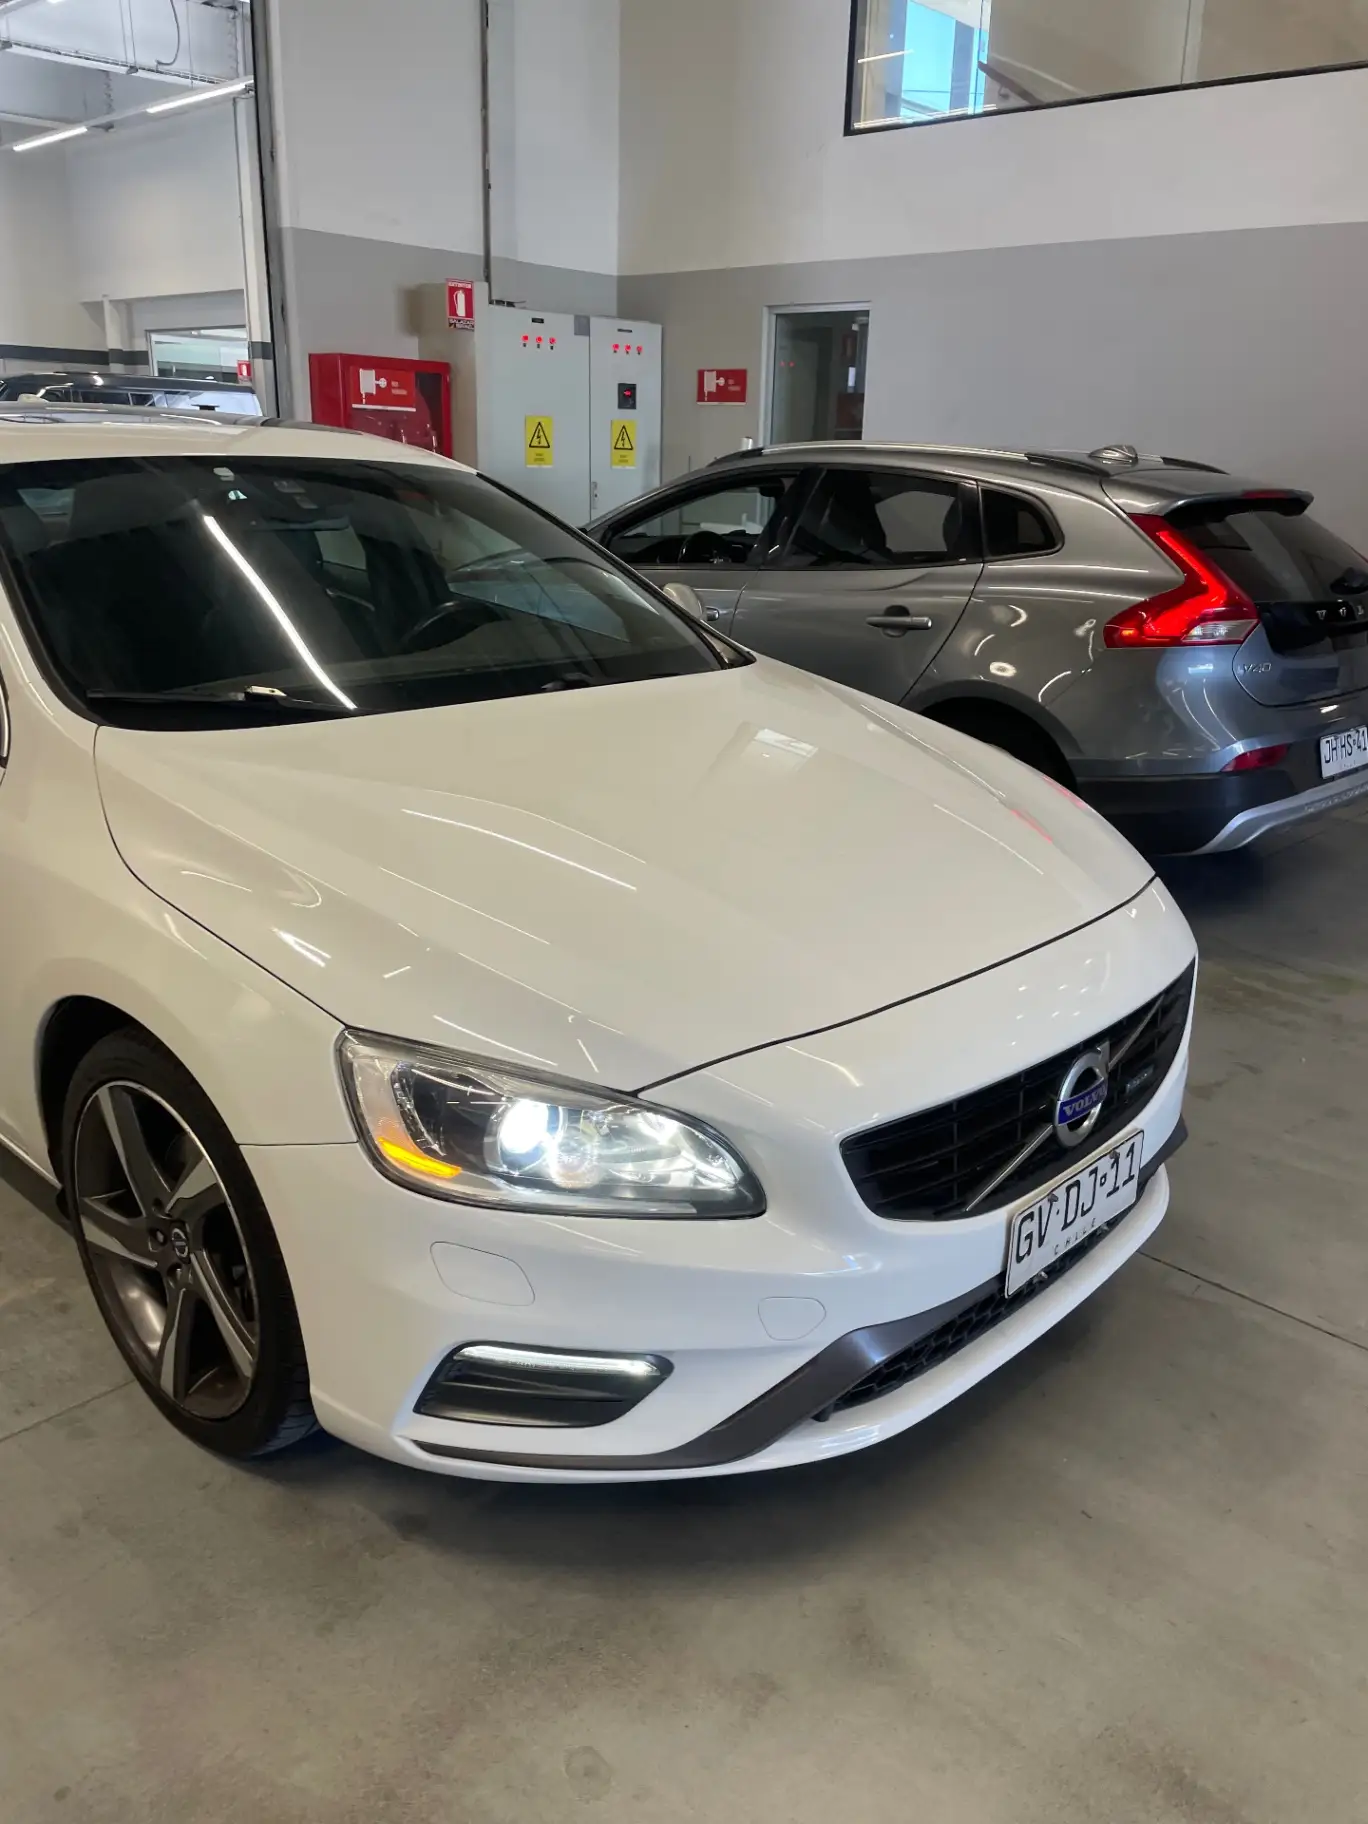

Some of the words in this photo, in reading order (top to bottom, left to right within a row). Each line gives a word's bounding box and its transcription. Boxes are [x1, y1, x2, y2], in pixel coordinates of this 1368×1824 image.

[1243, 662, 1272, 673] V40
[1062, 1084, 1106, 1117] VOLVO
[1052, 1217, 1097, 1256] CHILE
